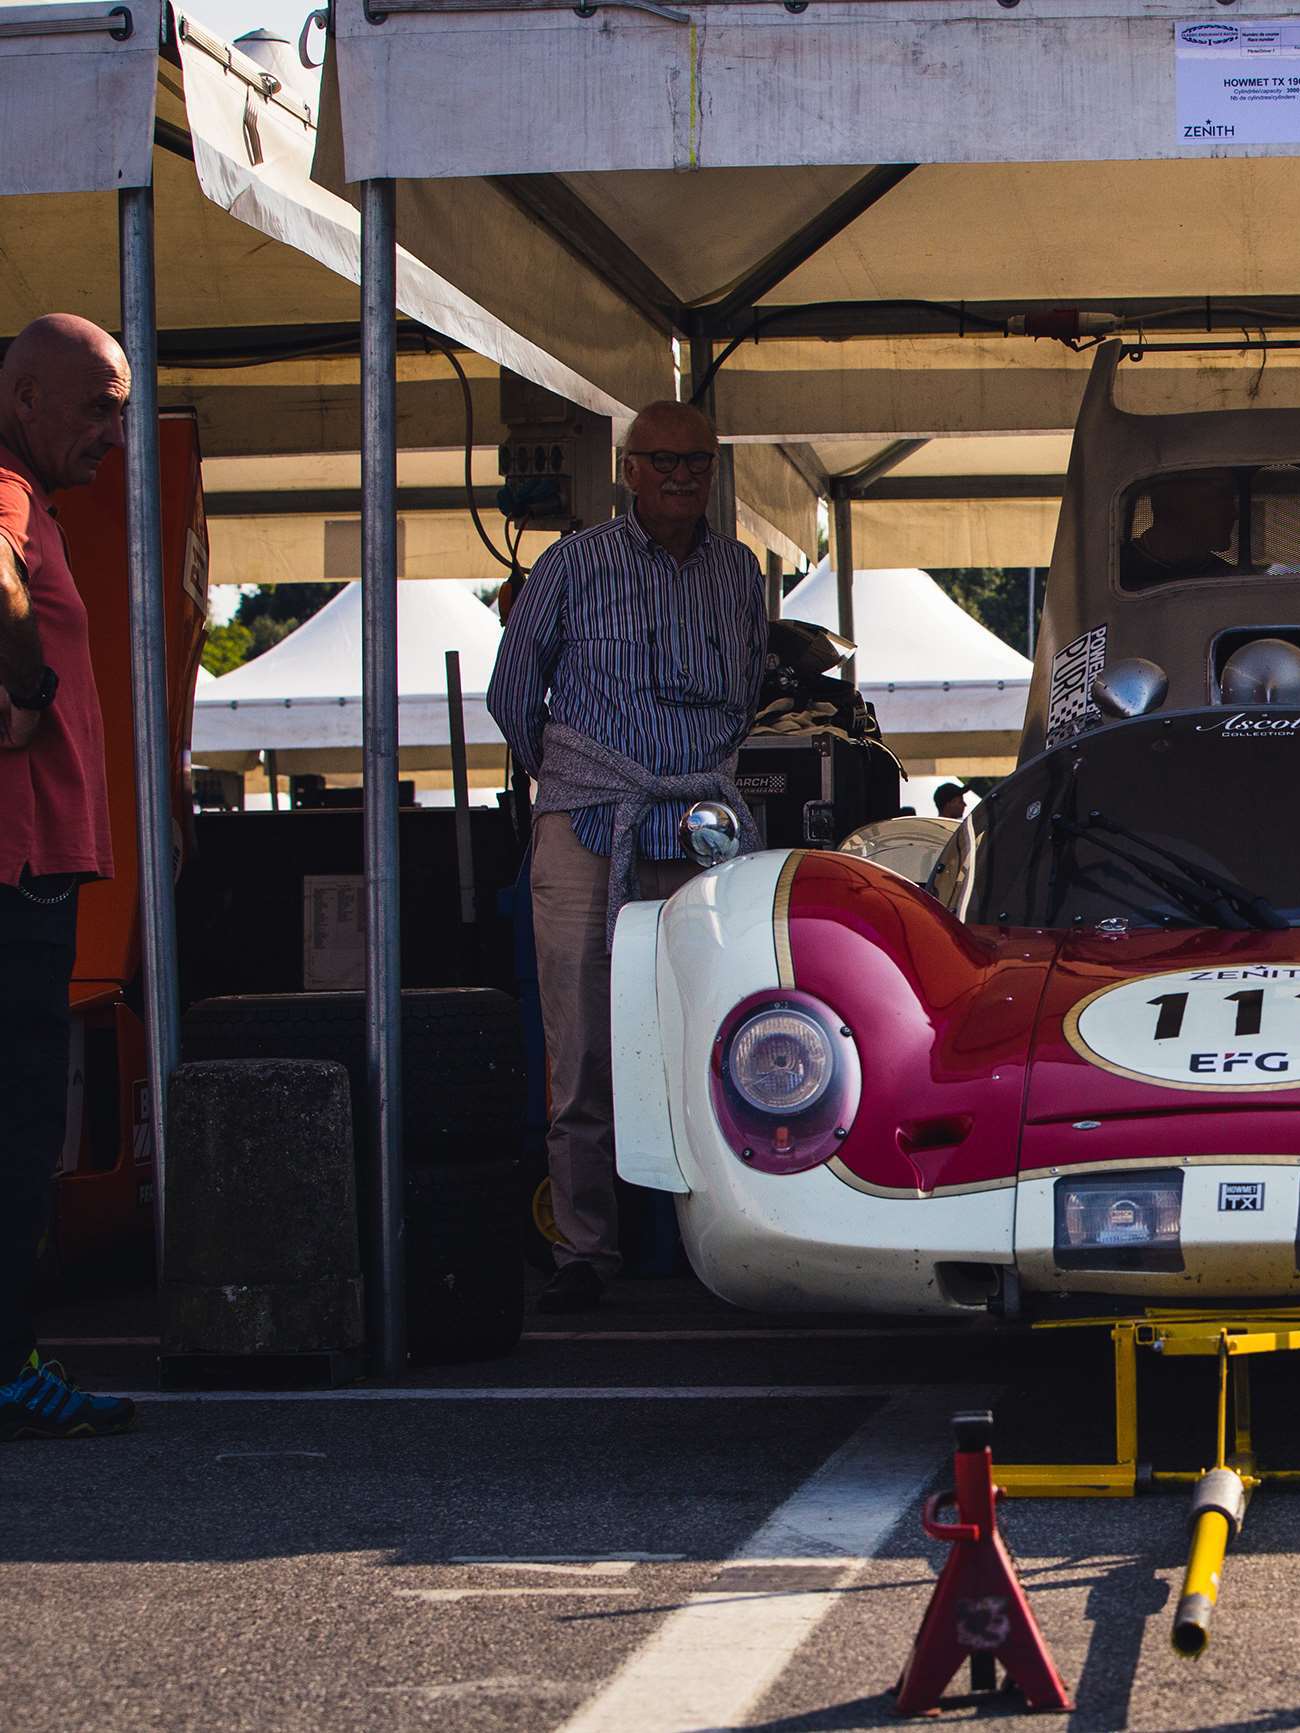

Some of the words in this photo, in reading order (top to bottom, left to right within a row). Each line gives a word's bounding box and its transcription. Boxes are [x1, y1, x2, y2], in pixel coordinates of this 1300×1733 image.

[1223, 78, 1269, 87] HOWMET
[1272, 77, 1285, 86] TX
[1183, 125, 1235, 137] ZENITH
[1050, 633, 1088, 714] PURE
[736, 778, 769, 786] ARCH
[1189, 1051, 1290, 1073] EFG
[1226, 1185, 1257, 1194] HOWMET
[1227, 1197, 1255, 1209] TX
